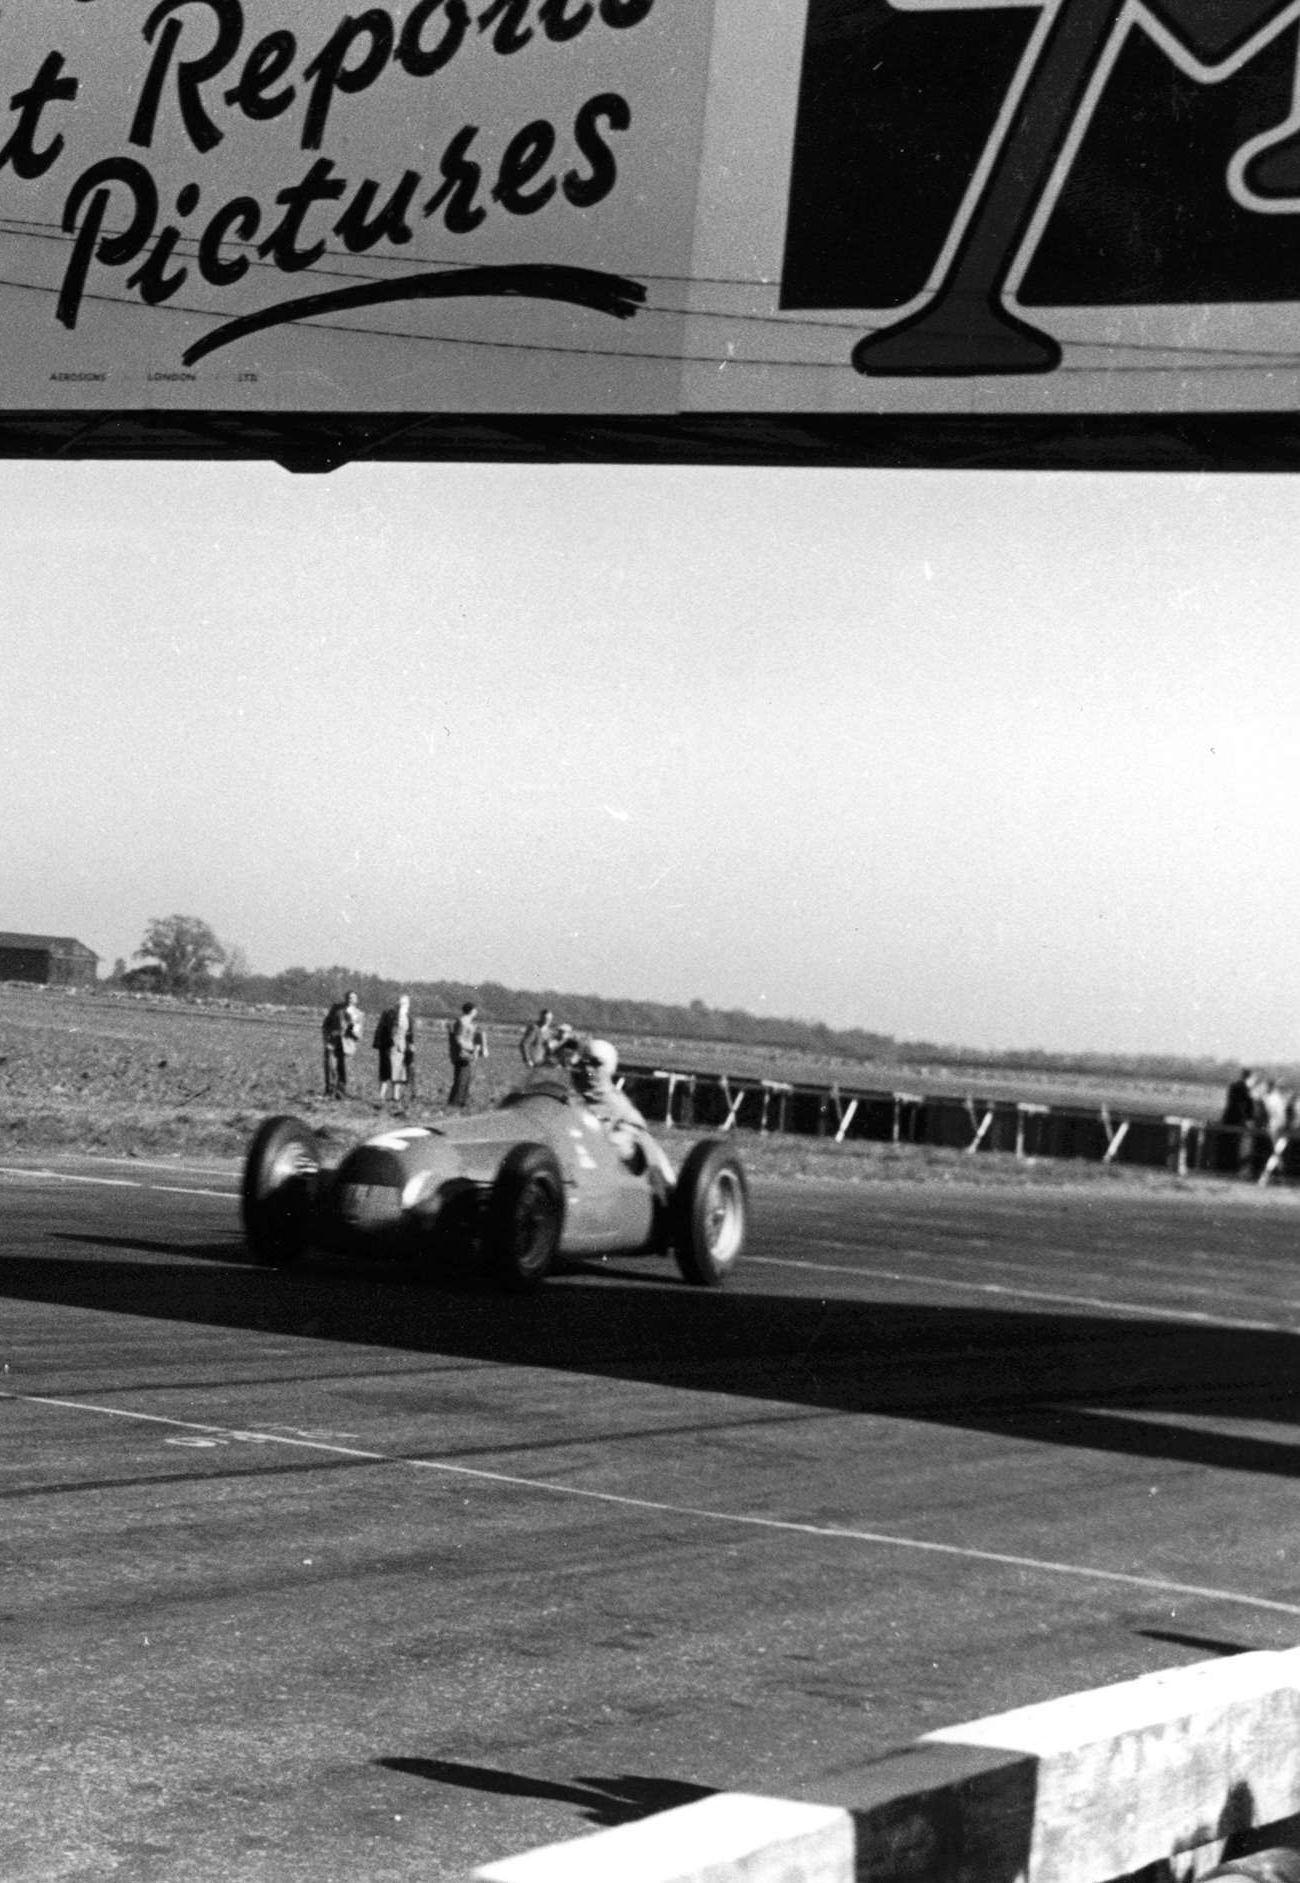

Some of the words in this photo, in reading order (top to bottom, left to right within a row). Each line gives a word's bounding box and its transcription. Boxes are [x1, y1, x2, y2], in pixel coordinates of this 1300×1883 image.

[129, 0, 654, 154] Repor
[55, 92, 631, 330] Pictures
[147, 371, 196, 382] LONDON
